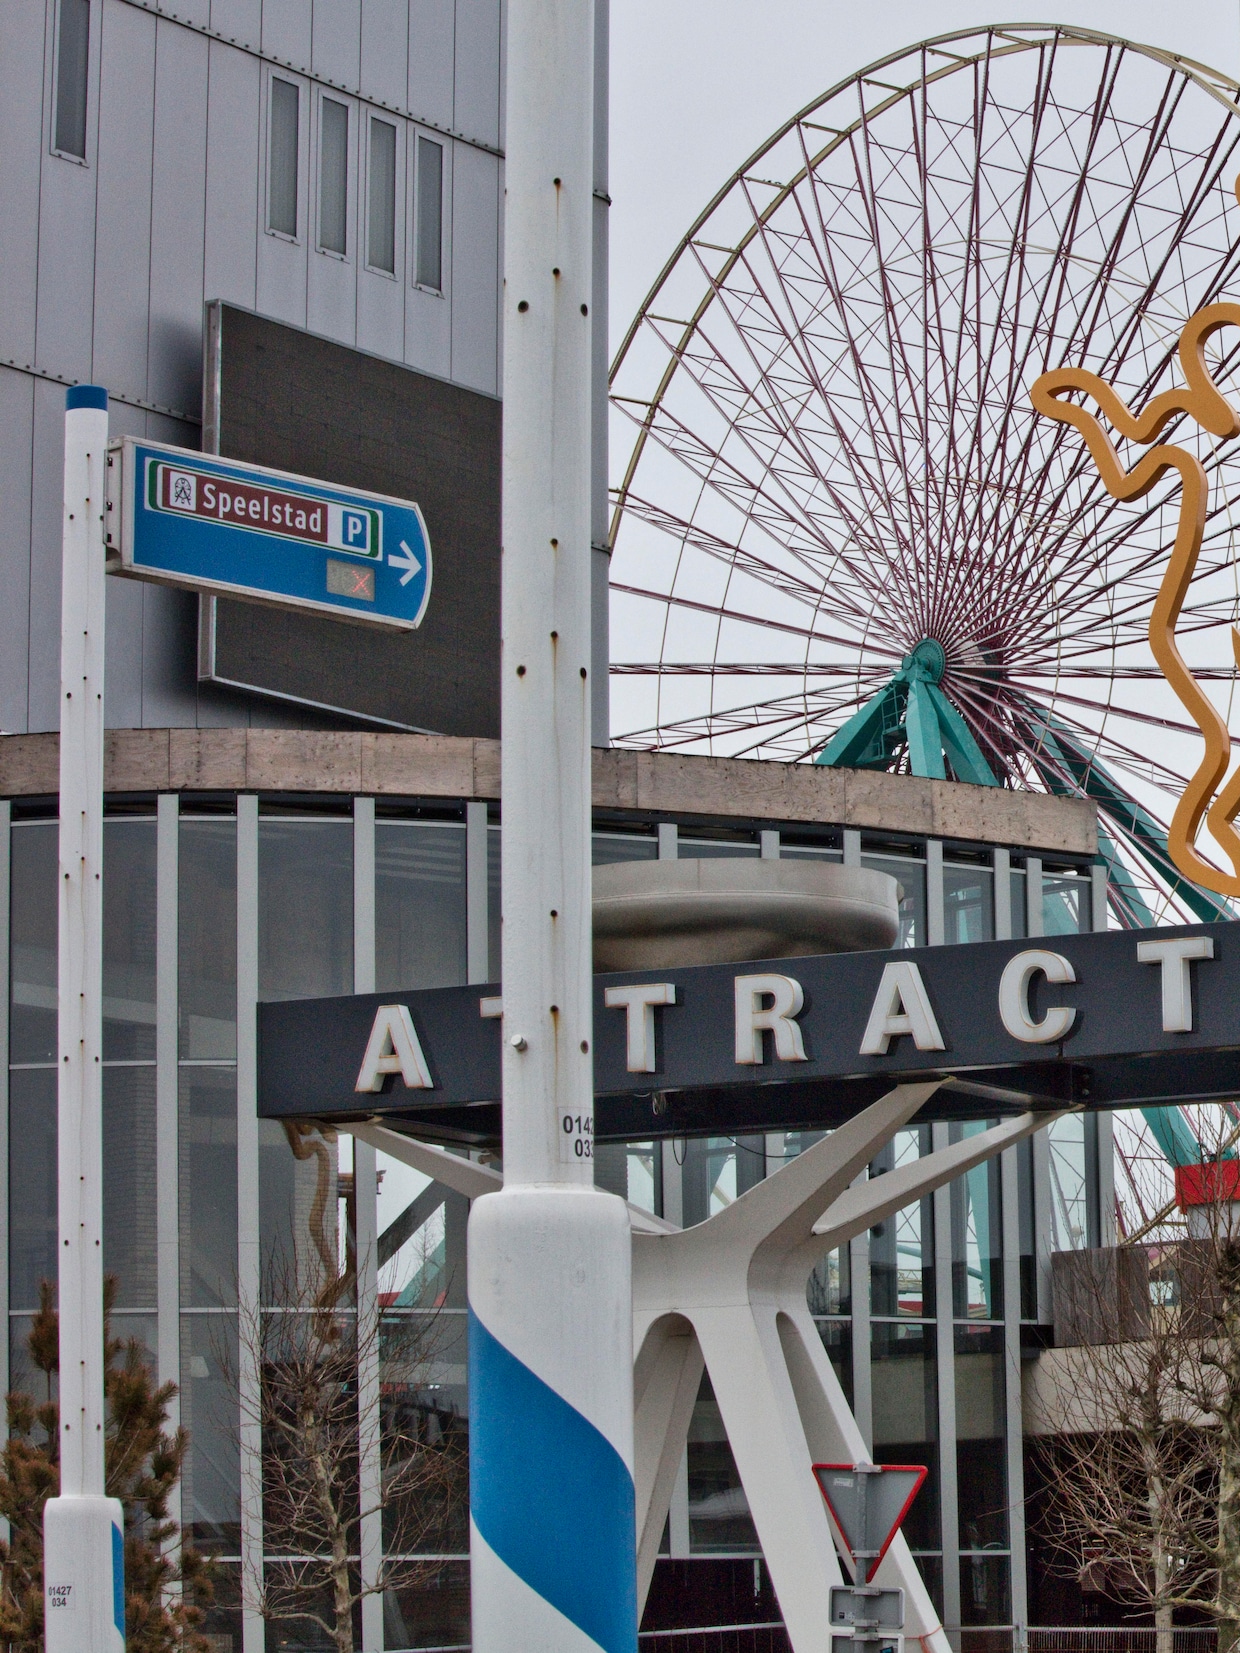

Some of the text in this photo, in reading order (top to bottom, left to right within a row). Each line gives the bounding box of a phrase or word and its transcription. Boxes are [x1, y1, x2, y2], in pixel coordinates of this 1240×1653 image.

[203, 483, 362, 543] Speelstad P
[48, 1586, 72, 1596] 01427
[51, 1597, 67, 1607] 034
